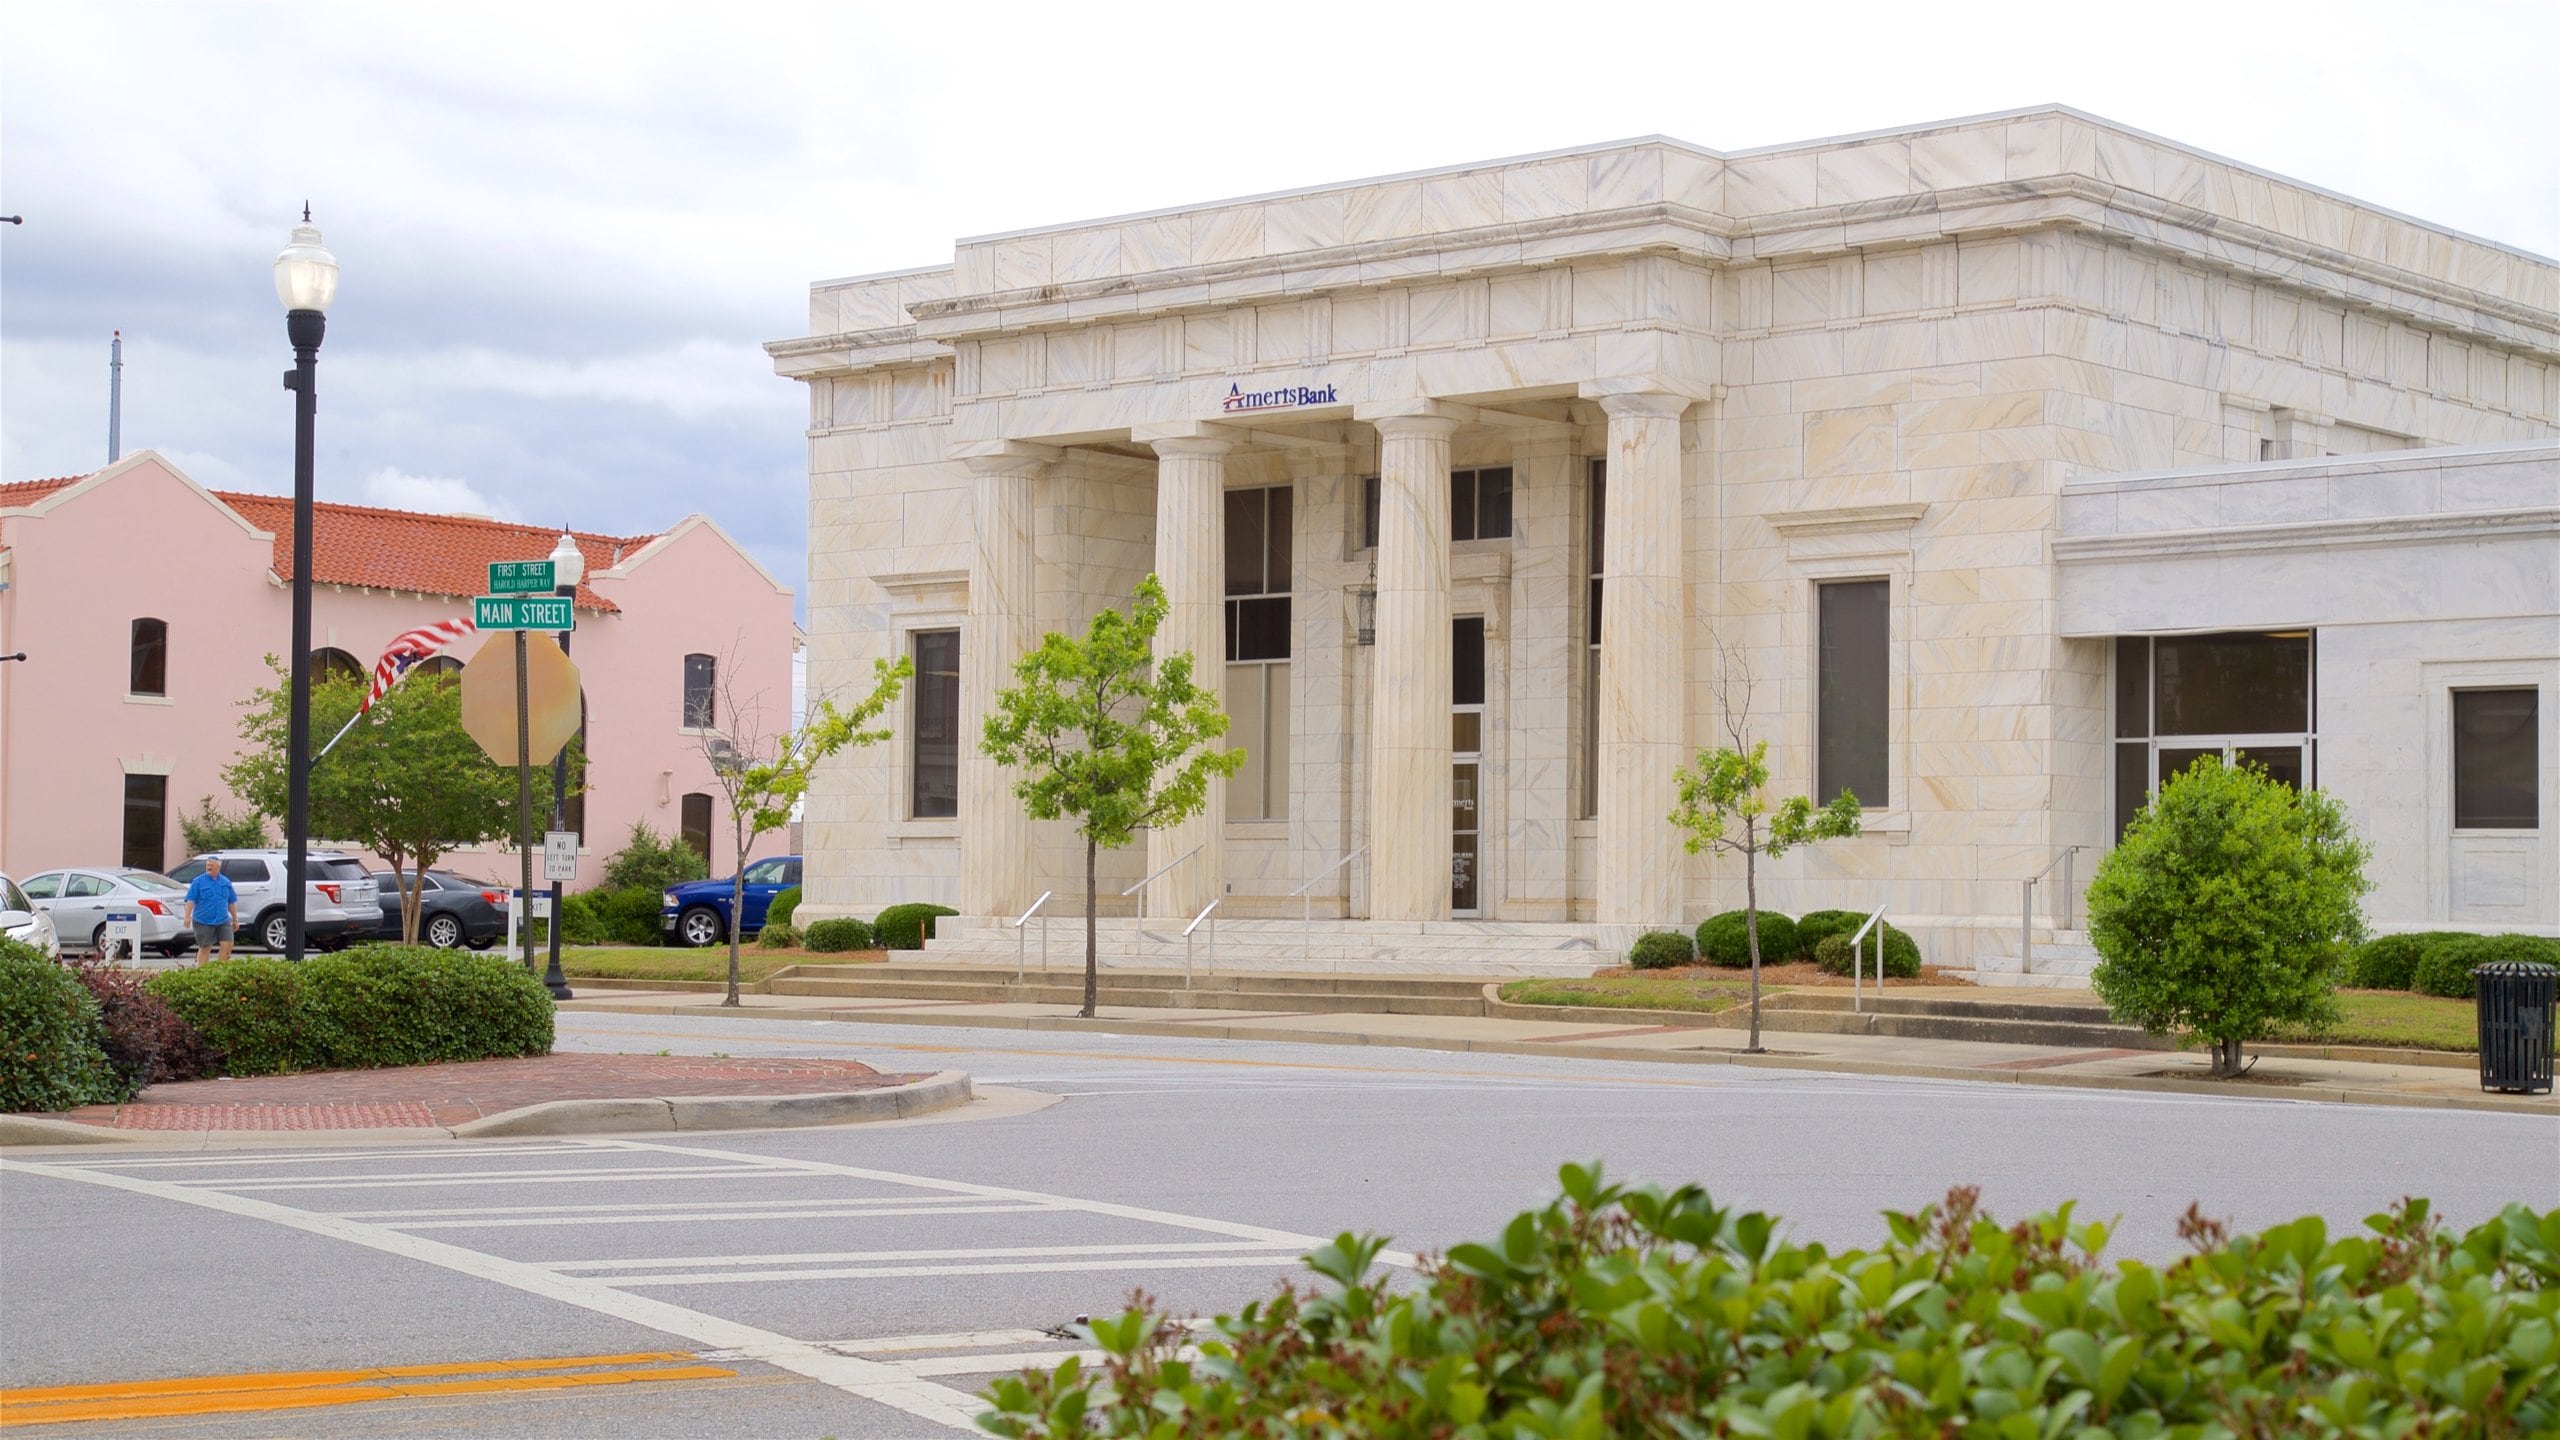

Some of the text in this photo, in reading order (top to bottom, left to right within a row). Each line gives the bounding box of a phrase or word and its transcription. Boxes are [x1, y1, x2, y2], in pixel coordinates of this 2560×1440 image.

[498, 563, 546, 577] FIRST STREET
[493, 578, 550, 590] HAROLD HARPER WAY
[481, 603, 566, 624] MAIN STREET
[556, 841, 566, 850] NO
[115, 926, 127, 934] EXIT
